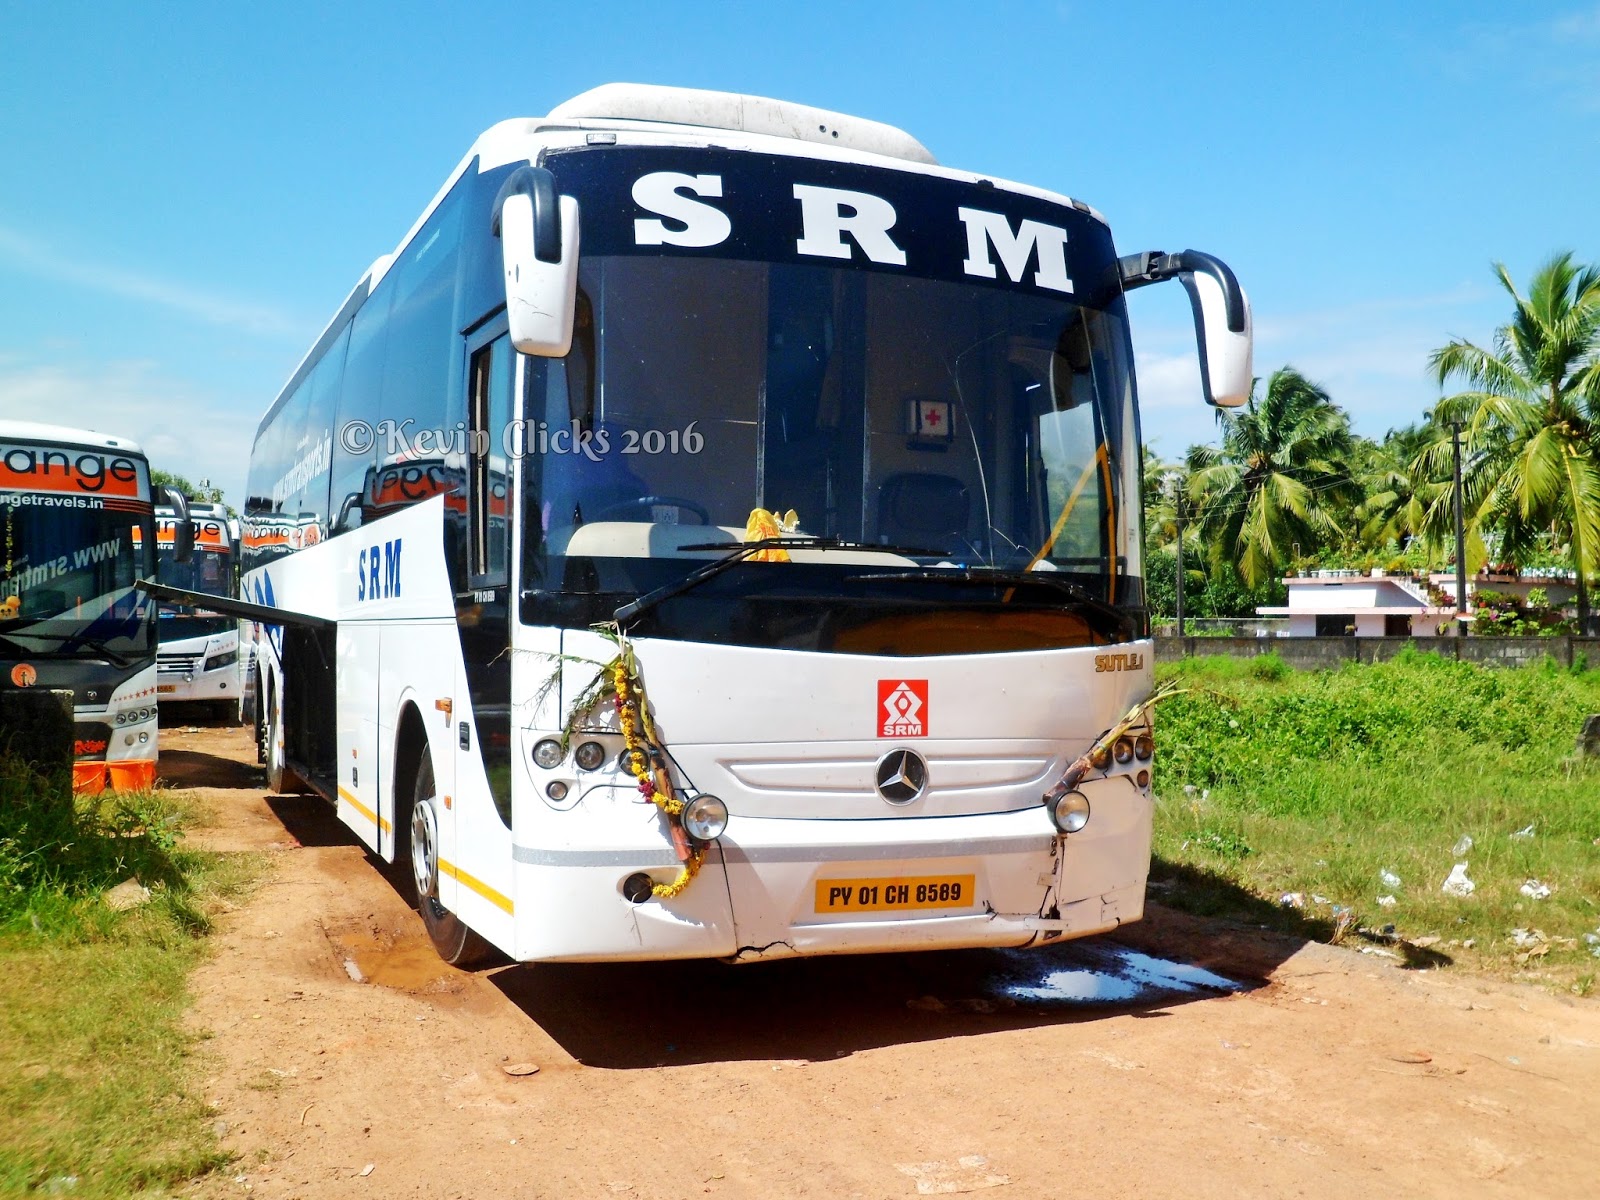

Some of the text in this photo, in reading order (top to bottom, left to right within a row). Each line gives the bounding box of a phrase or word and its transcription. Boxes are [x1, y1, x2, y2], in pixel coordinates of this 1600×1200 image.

[0, 448, 137, 492] ange
[358, 538, 402, 602] SRM
[1094, 653, 1144, 673] SUTLEJ
[883, 724, 923, 736] SRM
[829, 882, 962, 906] PY 01 CH 8589
